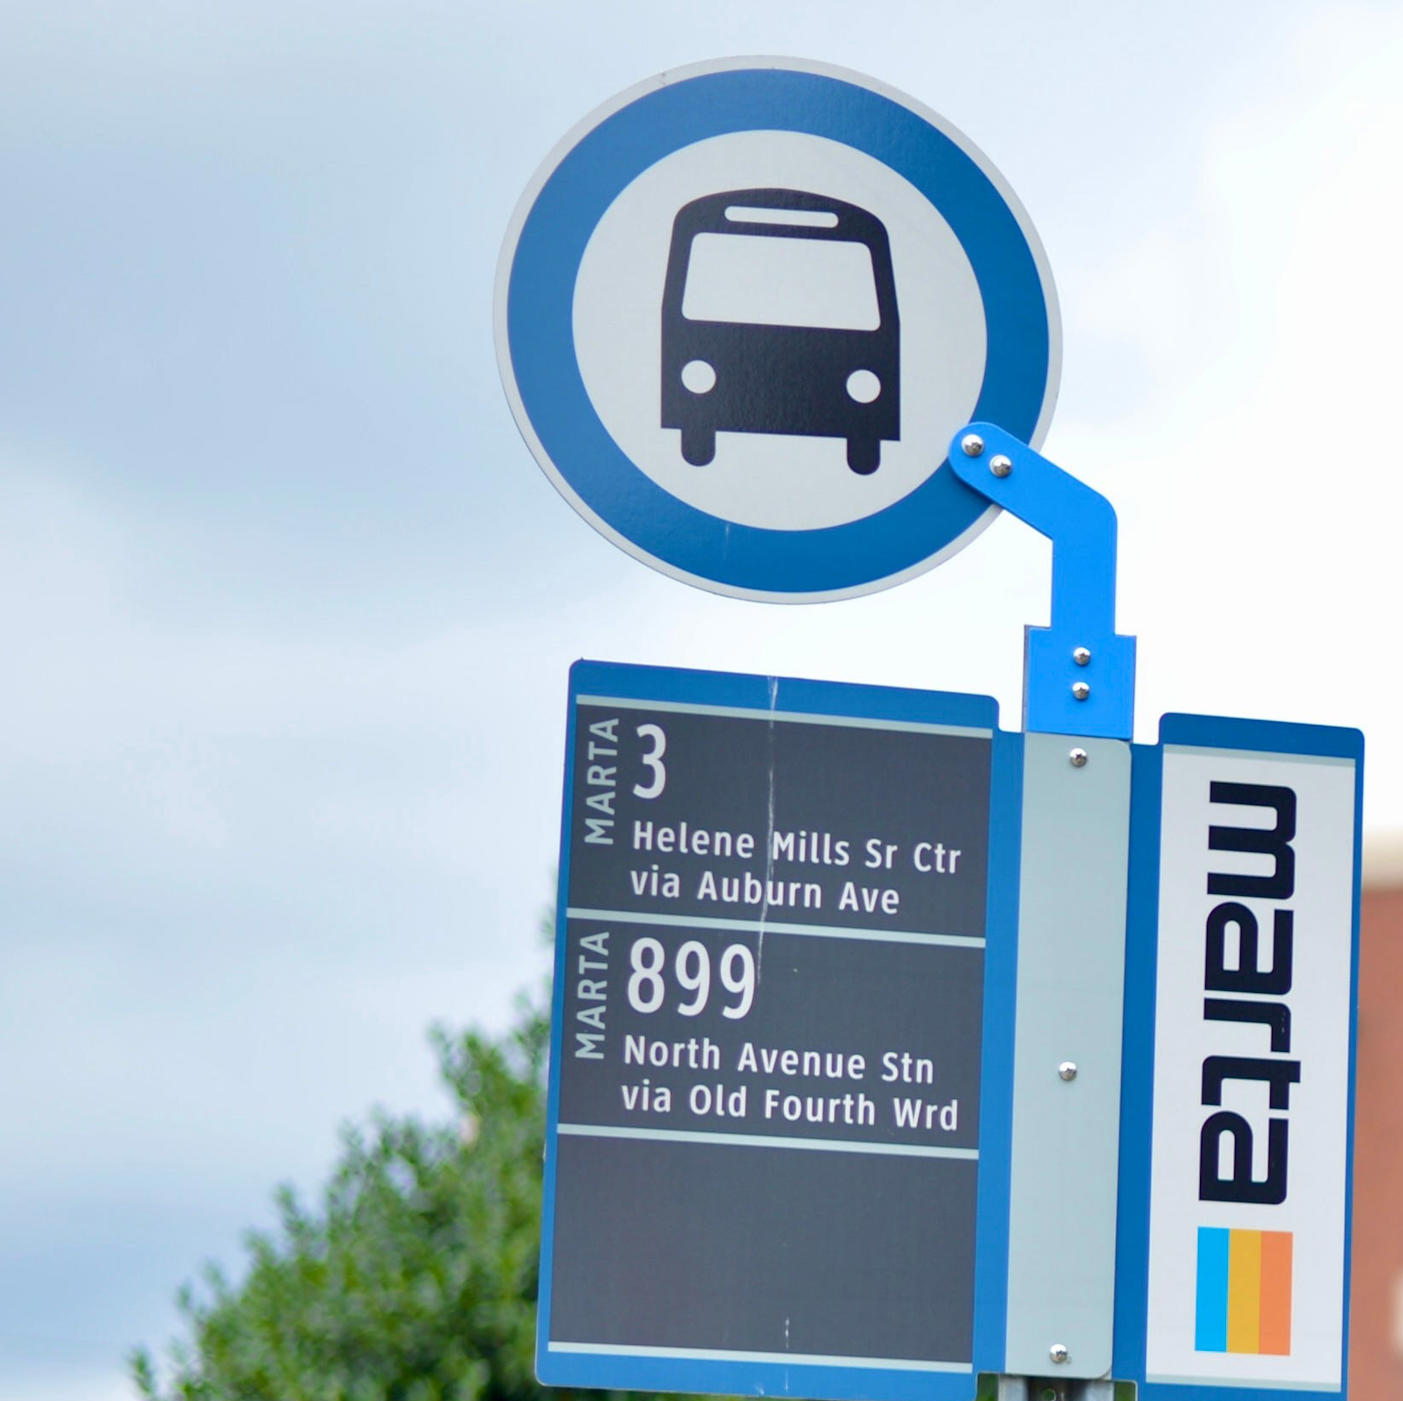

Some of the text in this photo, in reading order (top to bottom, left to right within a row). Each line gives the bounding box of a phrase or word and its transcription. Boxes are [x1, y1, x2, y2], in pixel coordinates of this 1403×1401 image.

[583, 717, 620, 845] MARTA
[632, 723, 666, 799] 3
[632, 820, 962, 874] Helene Mills Sr Ctr
[630, 864, 900, 914] via Auburn Ave
[574, 930, 610, 1060] MARTA
[627, 936, 756, 1020] 899
[1198, 779, 1301, 1205] marta
[623, 1034, 934, 1085] North Avenue Stn
[621, 1079, 958, 1131] via Old Fourth Wrd
